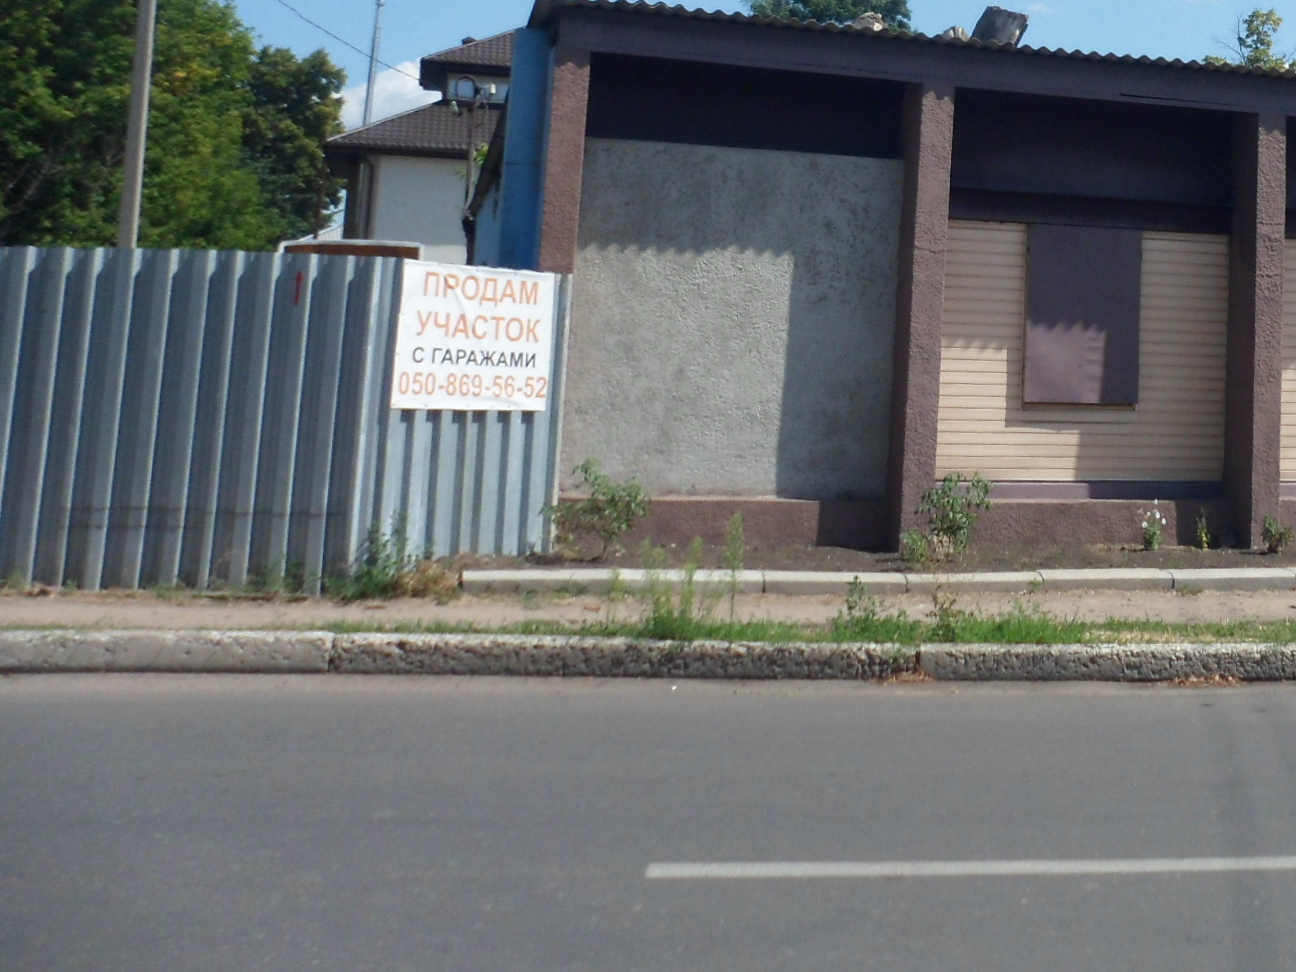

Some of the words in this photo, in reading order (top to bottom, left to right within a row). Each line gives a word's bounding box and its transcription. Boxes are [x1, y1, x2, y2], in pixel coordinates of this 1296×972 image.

[423, 271, 540, 307] ПРОДАМ
[416, 310, 541, 343] УЧАСТОК
[412, 347, 424, 364] С
[431, 348, 536, 369] ГАРАЖАМИ
[399, 371, 547, 399] 050-869-56-52
